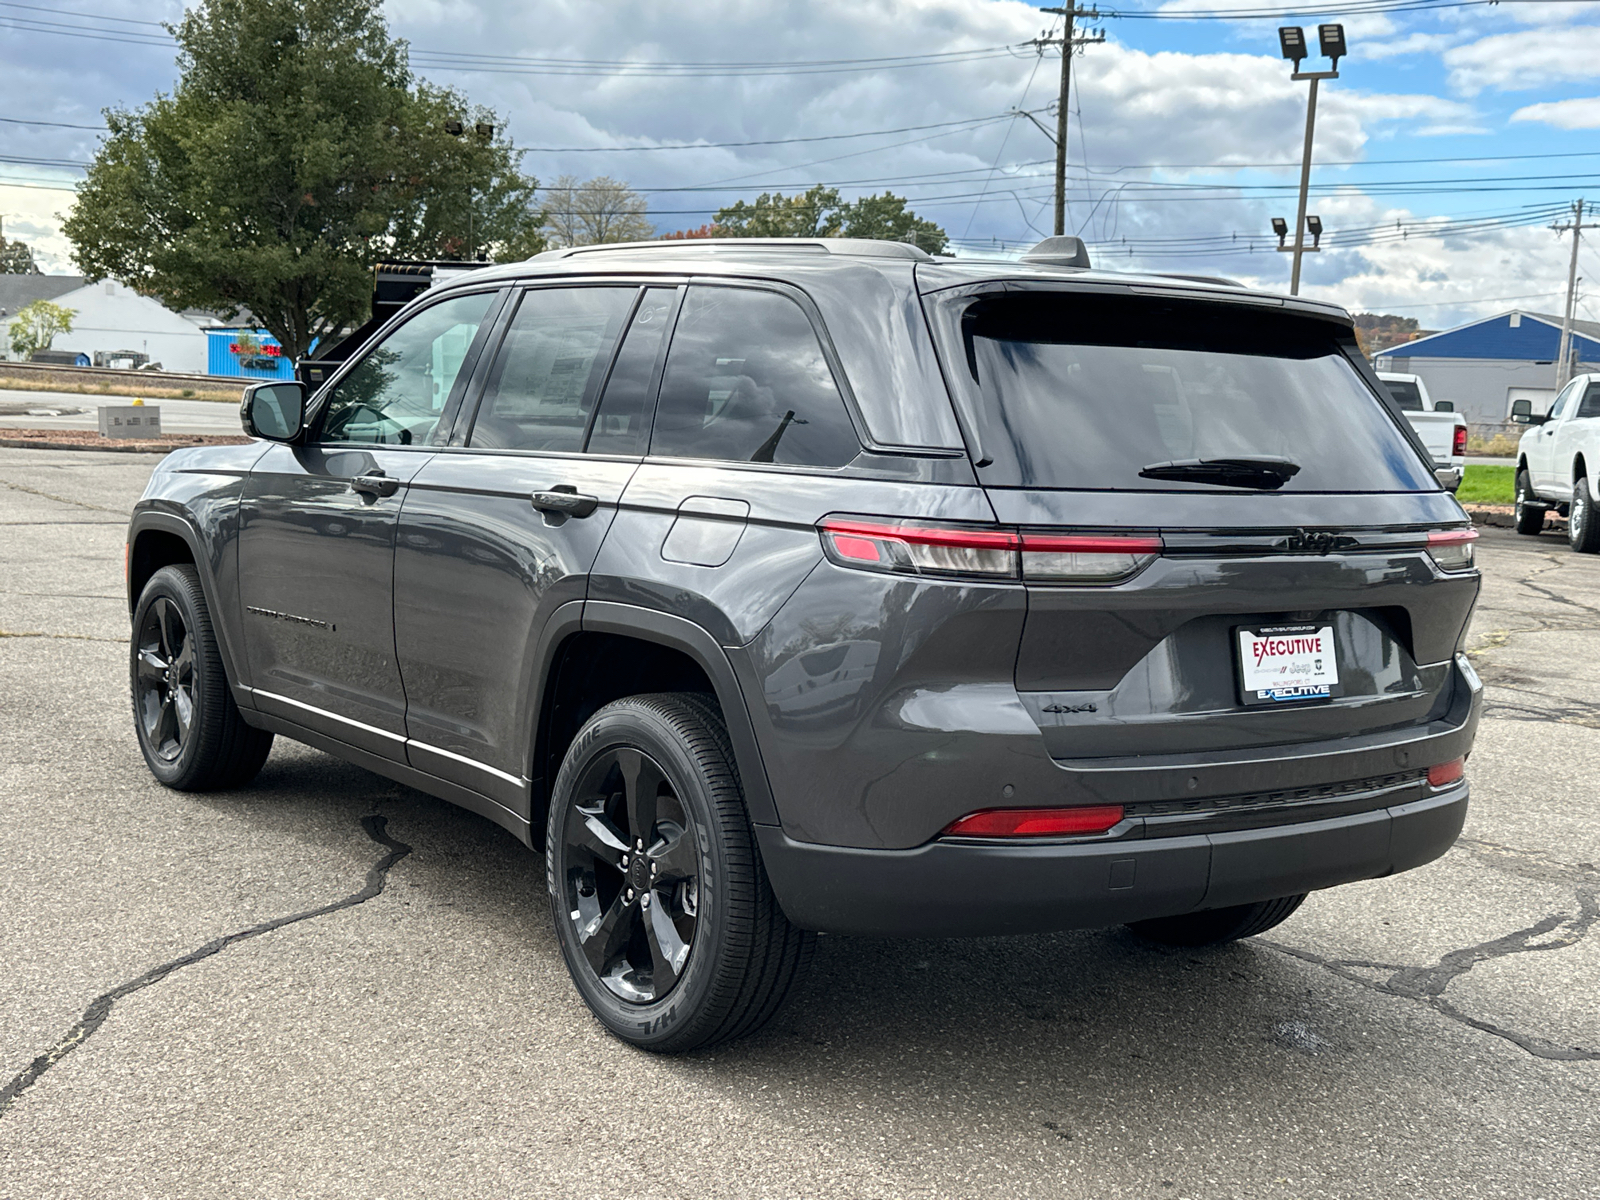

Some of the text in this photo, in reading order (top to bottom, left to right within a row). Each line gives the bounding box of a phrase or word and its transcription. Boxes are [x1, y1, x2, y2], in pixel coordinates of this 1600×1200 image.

[1292, 527, 1336, 556] Jeep
[1253, 637, 1322, 667] EXECUTIVE
[1257, 685, 1330, 700] EXECUTIVE
